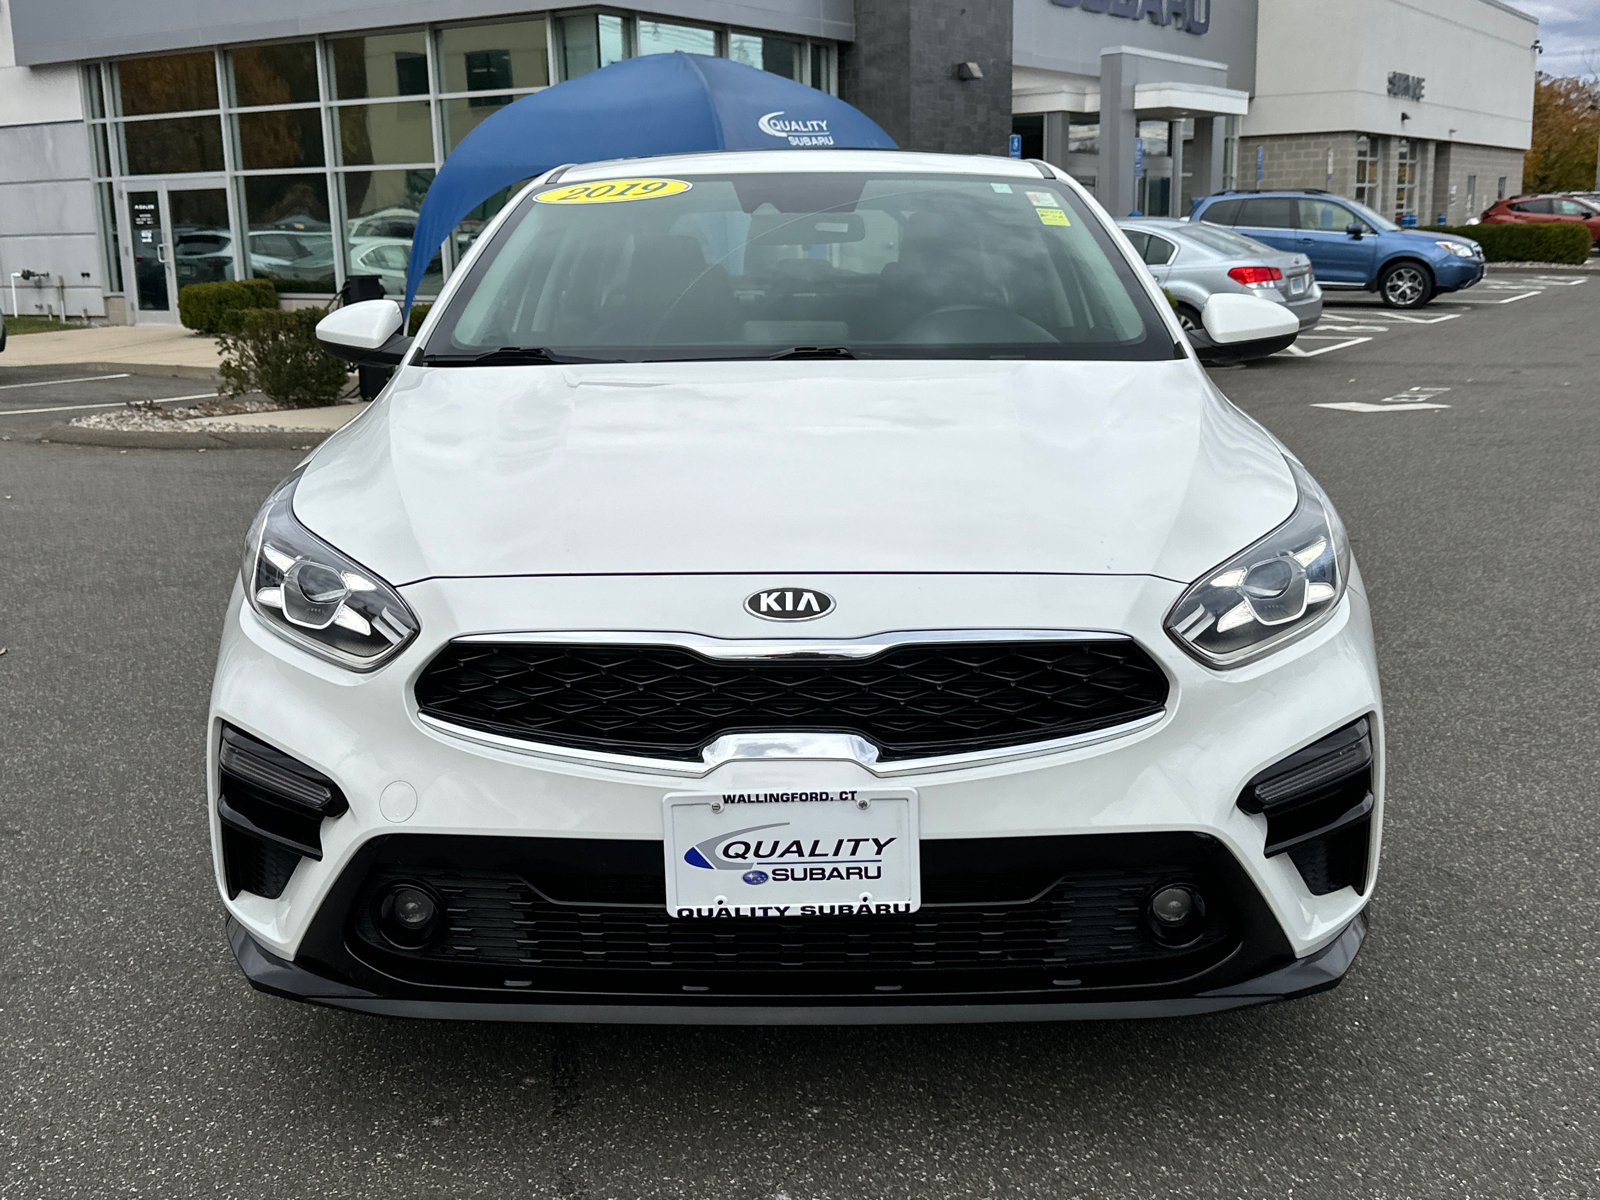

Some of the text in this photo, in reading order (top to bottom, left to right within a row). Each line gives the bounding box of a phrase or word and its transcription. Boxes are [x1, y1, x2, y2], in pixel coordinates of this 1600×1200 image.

[769, 119, 828, 132] QUALITY
[788, 136, 834, 146] SUBARU
[557, 181, 668, 201] 2019
[759, 591, 821, 612] KIA
[722, 791, 858, 804] WALLINGFORD, CT
[722, 837, 897, 860] QUALITY
[771, 866, 882, 882] SUBARU
[676, 903, 911, 919] QUALITY SUBARU
